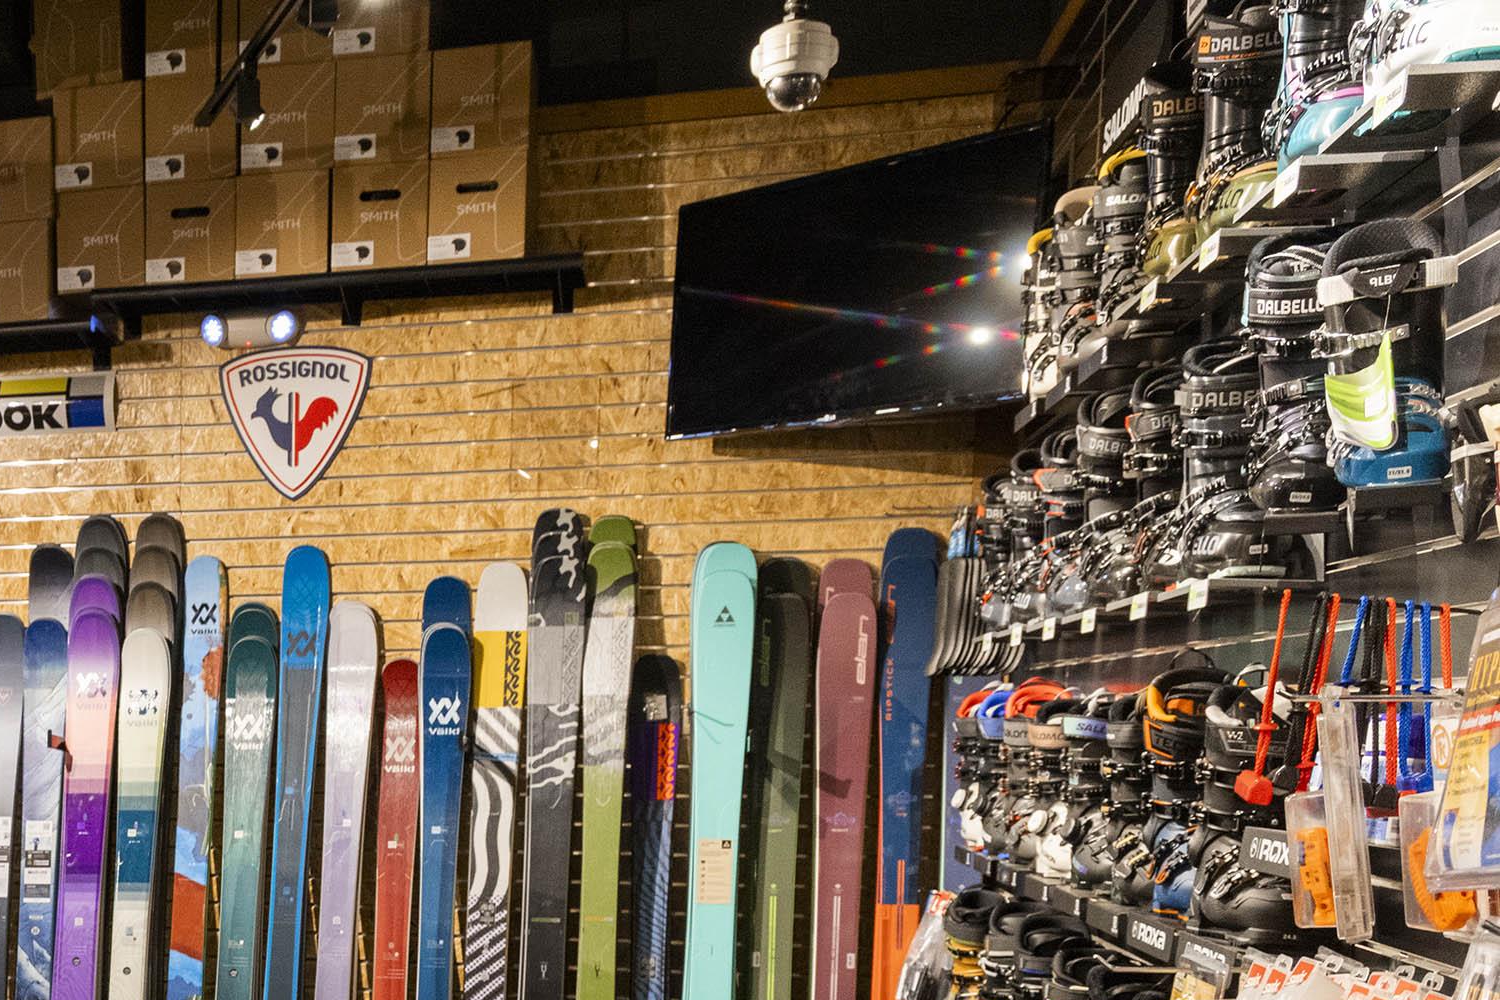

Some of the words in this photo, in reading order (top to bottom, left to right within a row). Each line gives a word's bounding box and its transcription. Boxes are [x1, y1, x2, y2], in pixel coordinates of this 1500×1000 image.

[173, 18, 211, 32] SMITH
[1209, 31, 1283, 54] DALBELL
[458, 92, 498, 107] SMITH
[363, 103, 402, 117] SMITH
[267, 111, 307, 125] SMITH
[80, 130, 116, 144] SMITH
[456, 202, 497, 216] SMITH
[358, 210, 399, 223] SMITH
[262, 219, 301, 232] SMITH
[81, 234, 119, 247] SMITH
[171, 228, 210, 241] SMITH
[237, 361, 351, 388] ROSSIGNOL
[758, 619, 771, 688] elan
[853, 614, 870, 686] elan
[885, 658, 894, 722] RIPSTICK
[1262, 838, 1290, 867] ROX
